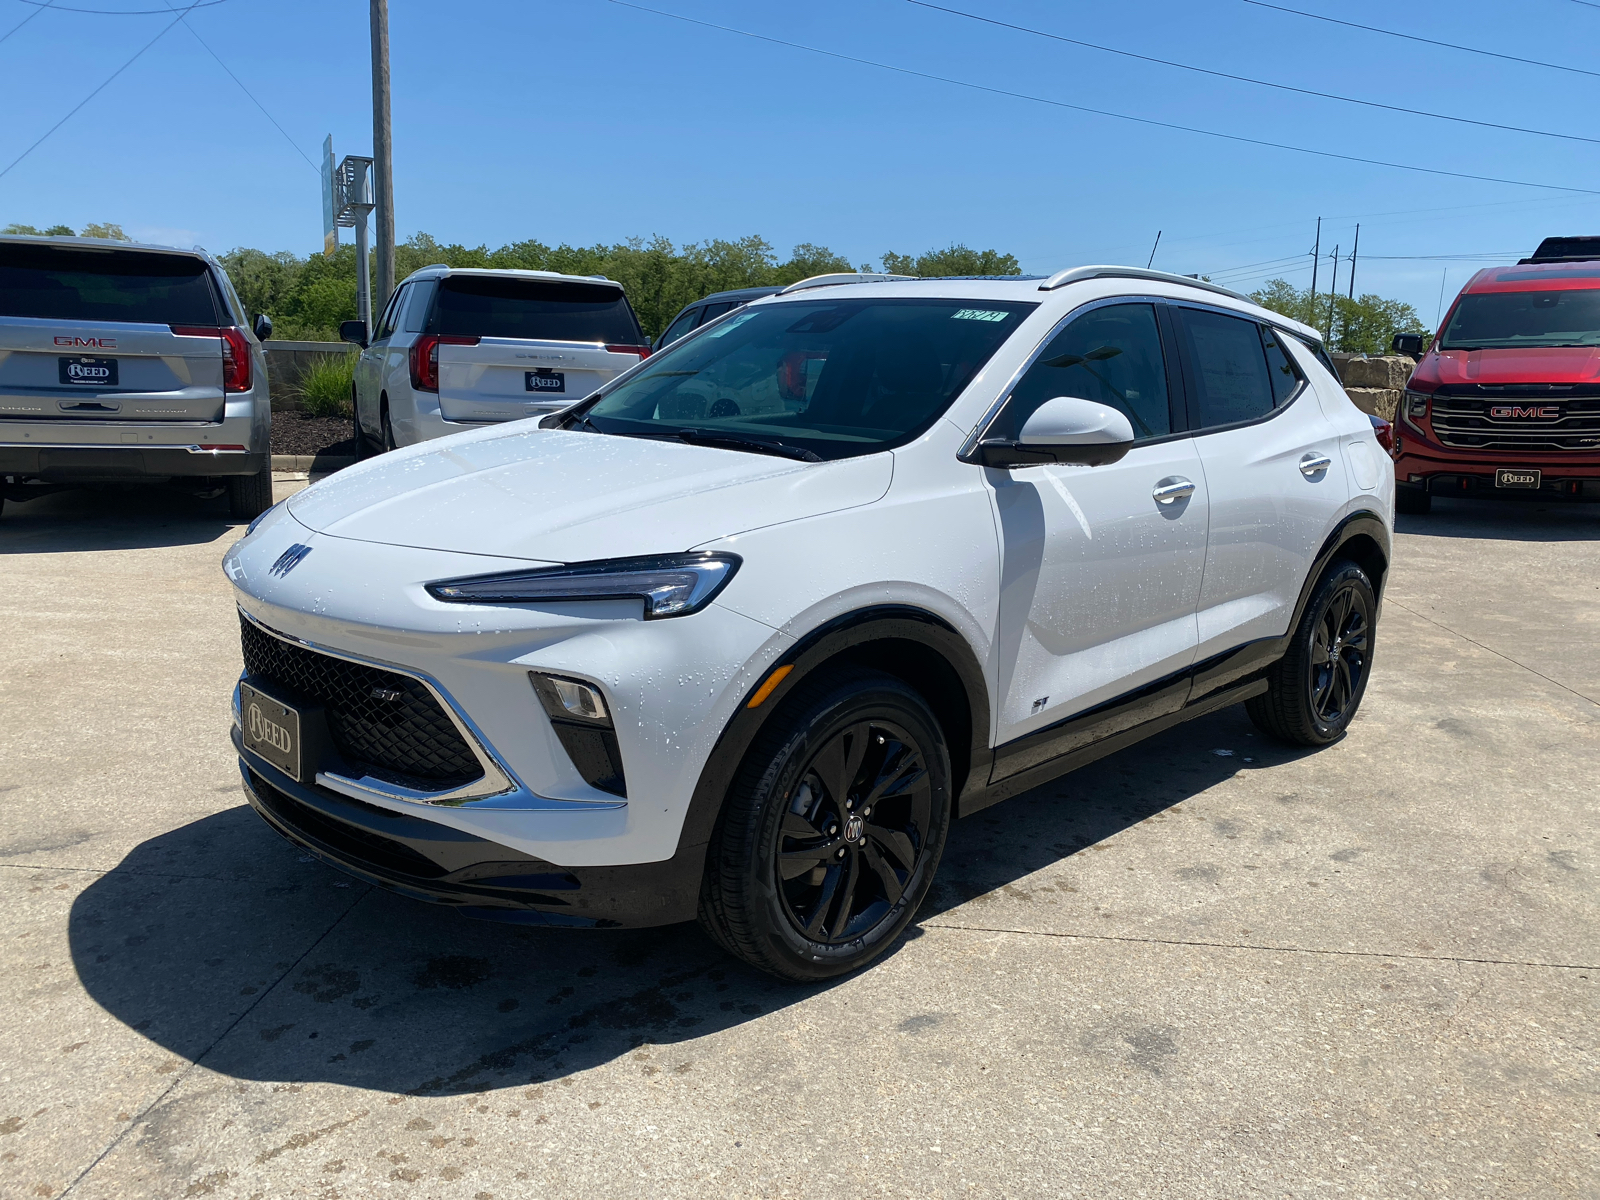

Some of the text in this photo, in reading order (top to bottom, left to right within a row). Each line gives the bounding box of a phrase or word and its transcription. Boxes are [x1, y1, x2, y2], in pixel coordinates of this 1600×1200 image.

[53, 335, 118, 349] GMC
[67, 363, 110, 379] REED
[530, 375, 561, 389] REED
[1490, 406, 1560, 418] GMC
[1501, 472, 1536, 484] REED
[371, 687, 400, 701] ST
[1032, 695, 1050, 709] ST
[248, 702, 292, 754] REED
